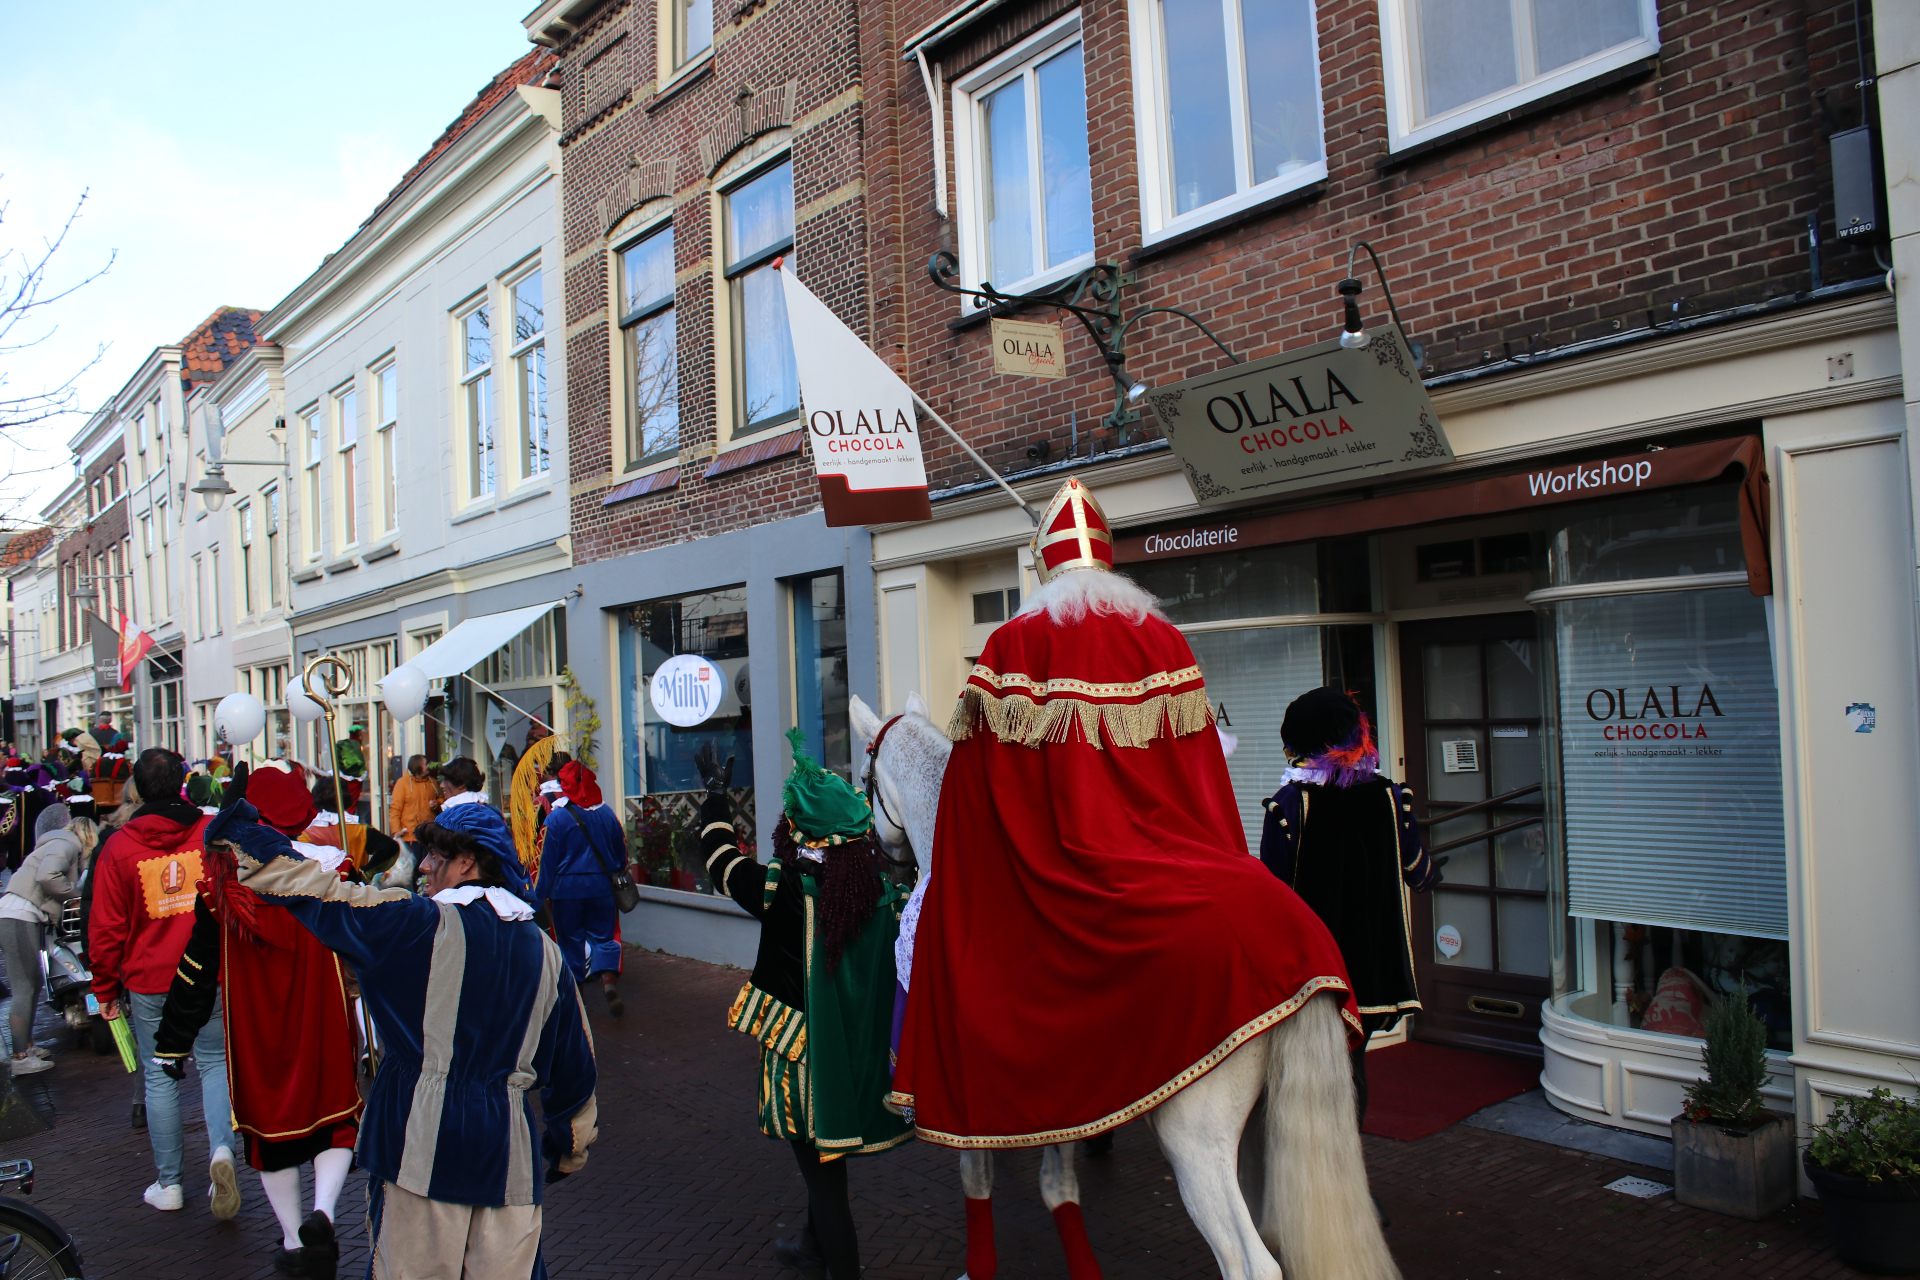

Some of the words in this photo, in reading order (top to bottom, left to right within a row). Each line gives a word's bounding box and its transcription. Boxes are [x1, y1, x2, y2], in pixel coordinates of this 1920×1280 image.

[1003, 338, 1053, 358] OLALA
[1206, 367, 1364, 434] OLALA
[810, 408, 914, 437] OLALA
[1240, 414, 1354, 454] CHOCOLA
[828, 437, 905, 453] CHOCOLA
[1240, 462, 1268, 475] eerlijk
[1275, 446, 1339, 469] handgemaakt
[1346, 441, 1377, 455] lekker
[822, 458, 842, 468] eerlijk
[847, 456, 892, 467] handgemaakt
[897, 455, 915, 463] lekker
[1528, 460, 1652, 497] Workshop
[1144, 525, 1238, 554] Chocolaterie
[659, 667, 710, 718] Milliy
[1586, 683, 1726, 721] OLALA
[1603, 723, 1708, 741] CHOCOLA
[1594, 748, 1619, 758] eerlijk
[1626, 747, 1687, 758] handgemaakt
[1695, 746, 1723, 756] lekker
[158, 900, 195, 911] SINTERKLAA
[1439, 935, 1459, 947] piggy
